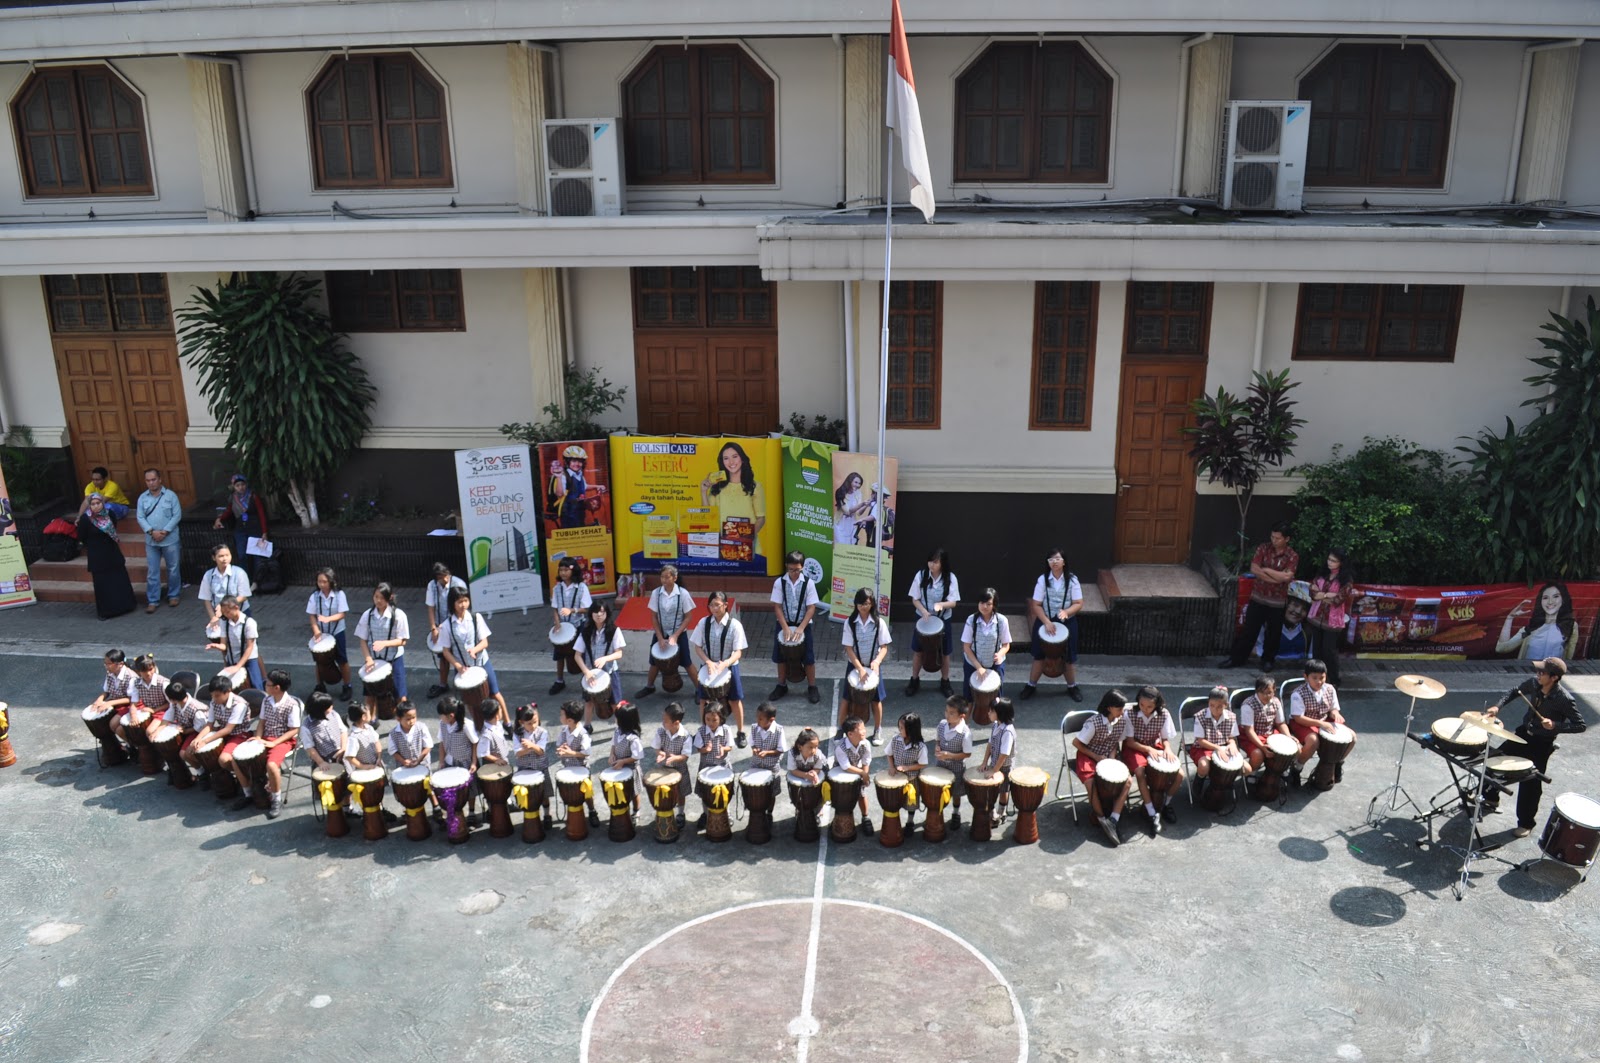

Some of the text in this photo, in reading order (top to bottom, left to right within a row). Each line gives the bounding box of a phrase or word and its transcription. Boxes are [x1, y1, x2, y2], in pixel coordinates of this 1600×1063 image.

[633, 443, 695, 454] HOLISTICARE
[469, 484, 497, 498] KEEP
[470, 492, 524, 507] BANDUNG
[476, 503, 524, 516] BEAUTIFUL
[501, 512, 524, 525] EUY
[1447, 605, 1475, 620] Kids
